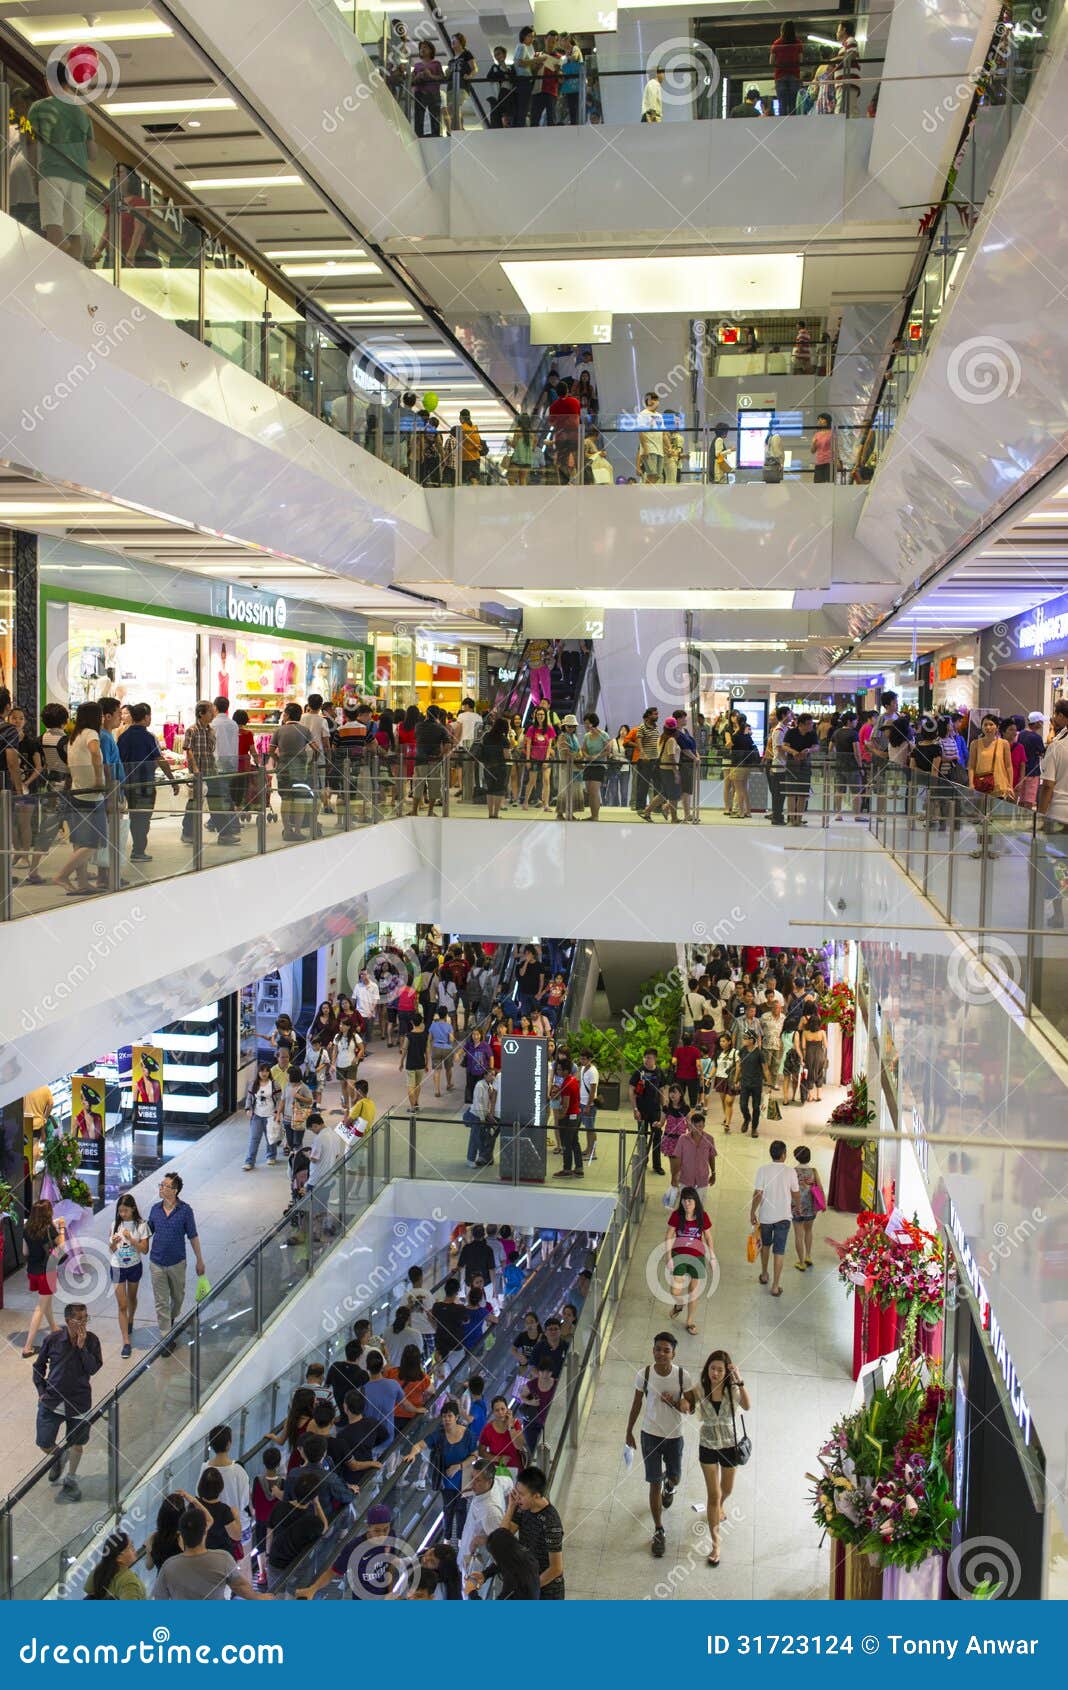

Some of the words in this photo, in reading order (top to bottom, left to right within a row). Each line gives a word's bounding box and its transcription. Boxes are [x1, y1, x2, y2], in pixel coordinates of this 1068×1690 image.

[228, 584, 274, 627] bossini
[585, 620, 604, 639] L2
[535, 1045, 543, 1077] Directory
